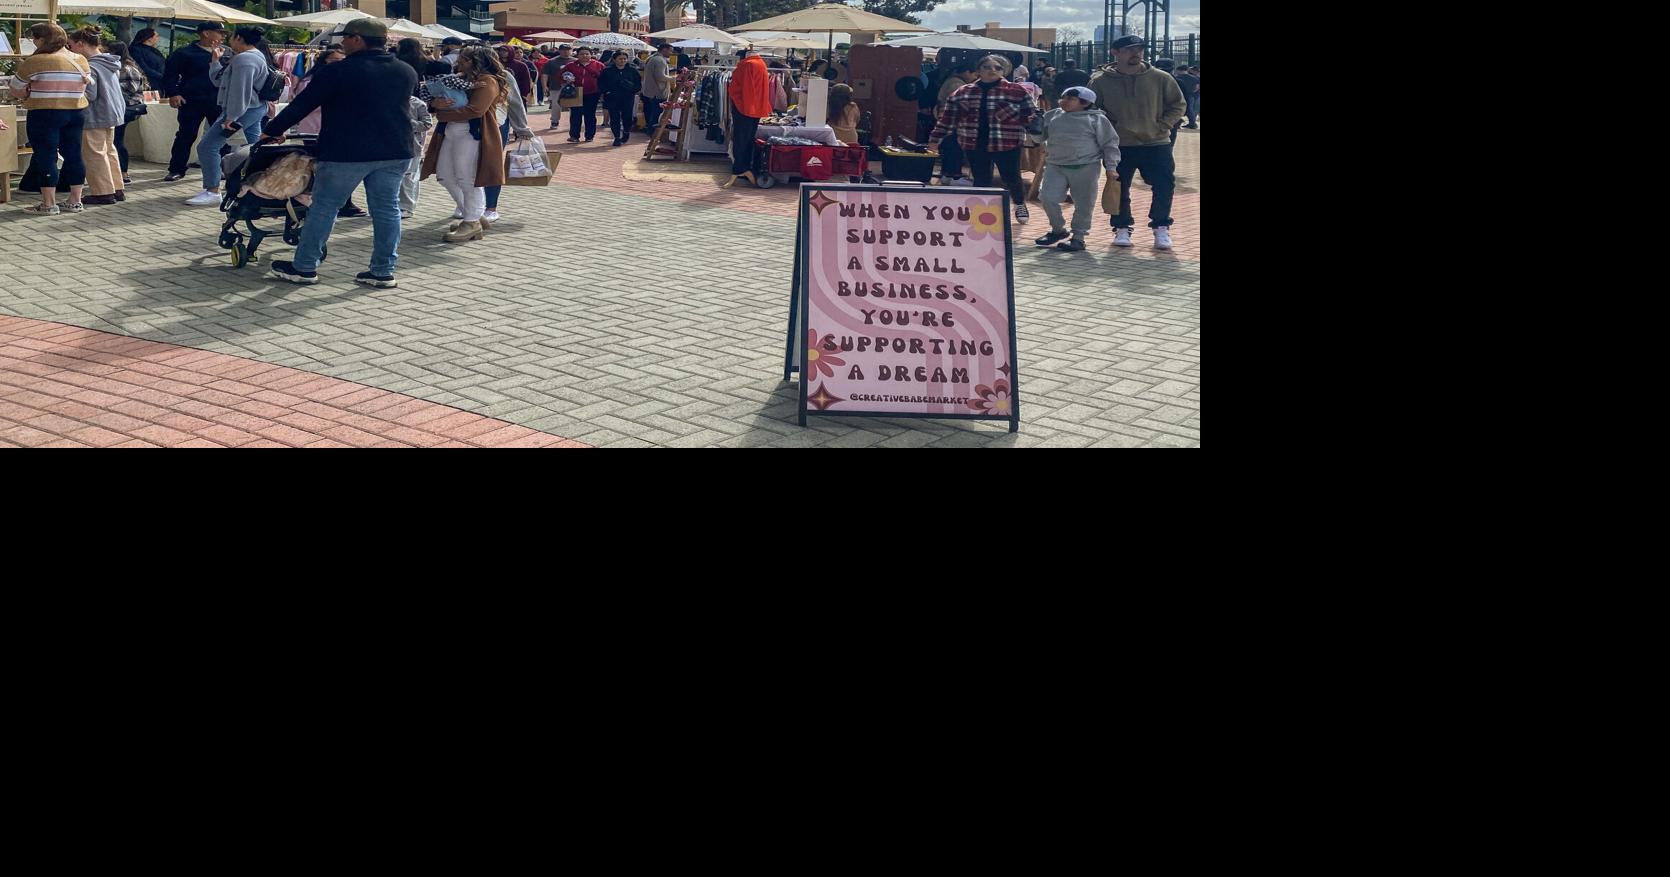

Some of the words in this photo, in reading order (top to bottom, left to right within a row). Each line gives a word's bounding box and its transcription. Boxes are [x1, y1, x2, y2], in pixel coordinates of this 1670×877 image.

[839, 203, 910, 219] WHEN
[922, 205, 971, 221] YOU
[846, 229, 965, 247] SUPPORT
[847, 256, 862, 270] A
[875, 256, 965, 273] SMALL
[837, 281, 976, 303] BUSINESS,
[860, 309, 955, 327] YOU'RE
[823, 334, 994, 356] SUPPORTING
[847, 364, 865, 381] A
[878, 365, 970, 384] DREAM
